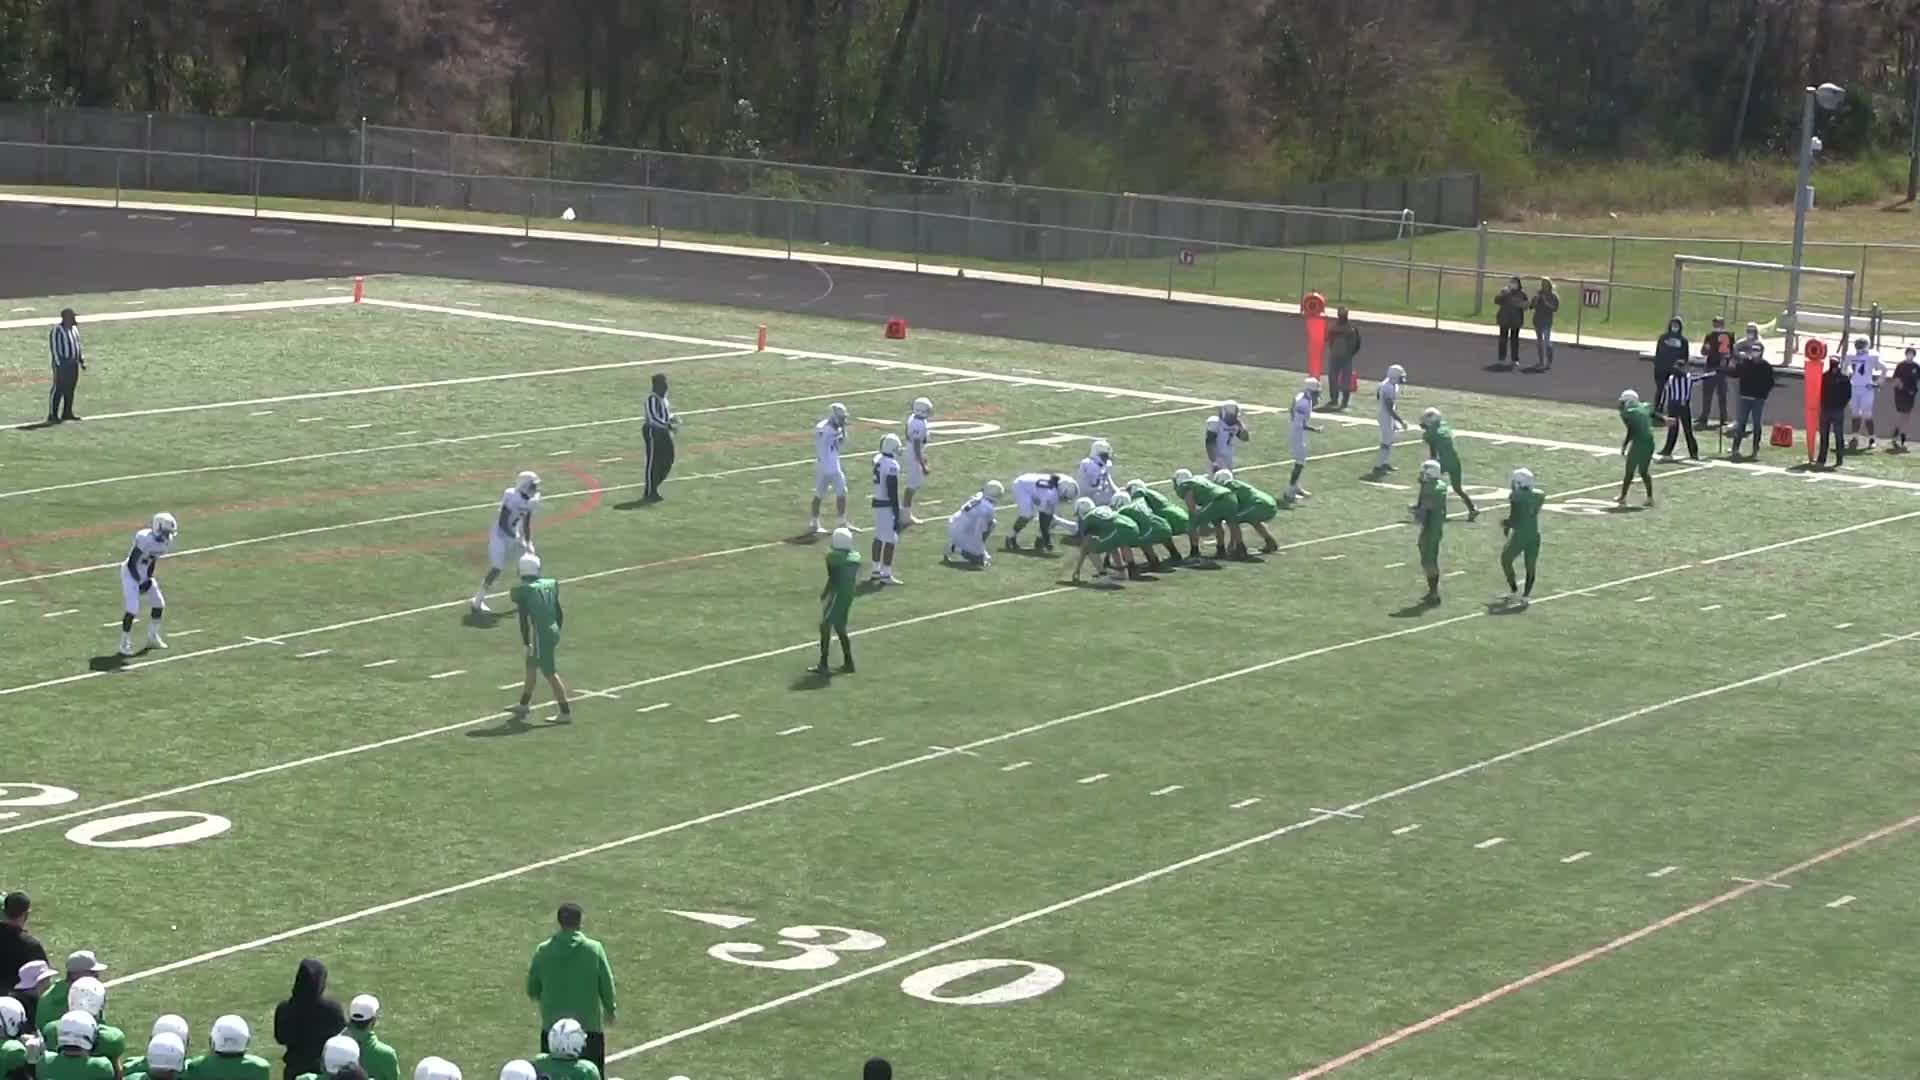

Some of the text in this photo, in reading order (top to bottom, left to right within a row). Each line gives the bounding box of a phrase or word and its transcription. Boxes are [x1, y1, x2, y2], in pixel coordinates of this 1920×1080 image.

[1585, 291, 1599, 305] 10
[1718, 334, 1730, 353] 2
[707, 925, 1066, 1005] 30
